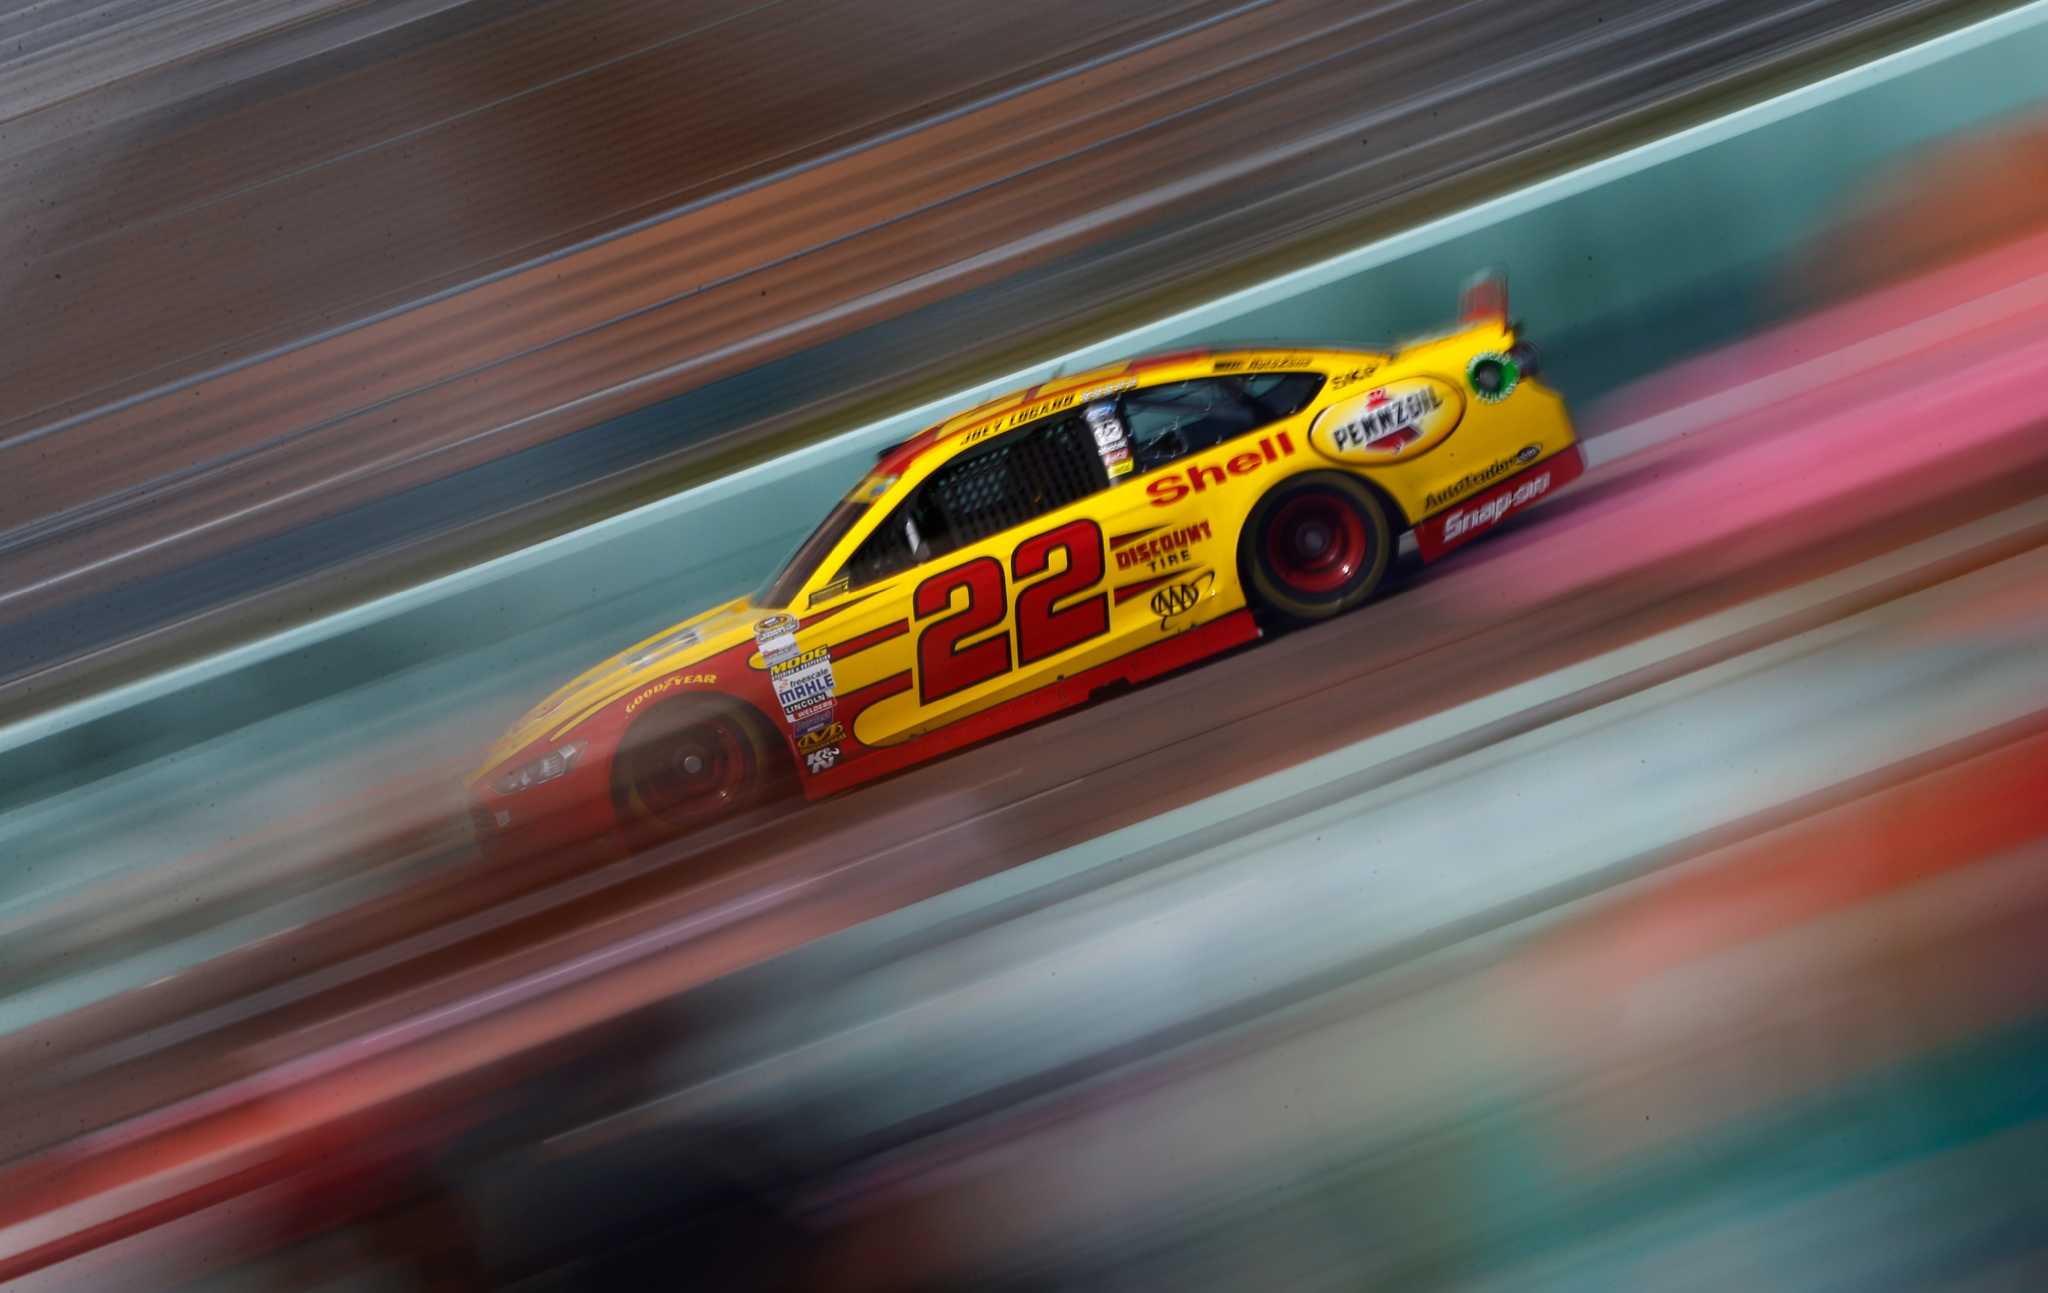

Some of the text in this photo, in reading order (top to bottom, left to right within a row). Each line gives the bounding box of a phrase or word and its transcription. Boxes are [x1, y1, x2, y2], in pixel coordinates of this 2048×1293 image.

[1333, 385, 1444, 453] PENNZOIL
[1146, 431, 1296, 508] Shell
[1443, 471, 1551, 543] Snap-on
[1115, 519, 1213, 571] DISCOUNT
[1147, 549, 1191, 573] TIRE
[913, 518, 1110, 707] 22
[1155, 583, 1197, 615] AAA
[770, 645, 828, 674] MOOG
[624, 673, 718, 713] GOODYEAR
[779, 674, 835, 705] MAHLE
[789, 668, 829, 688] freescale
[784, 693, 828, 715] LINCOLN
